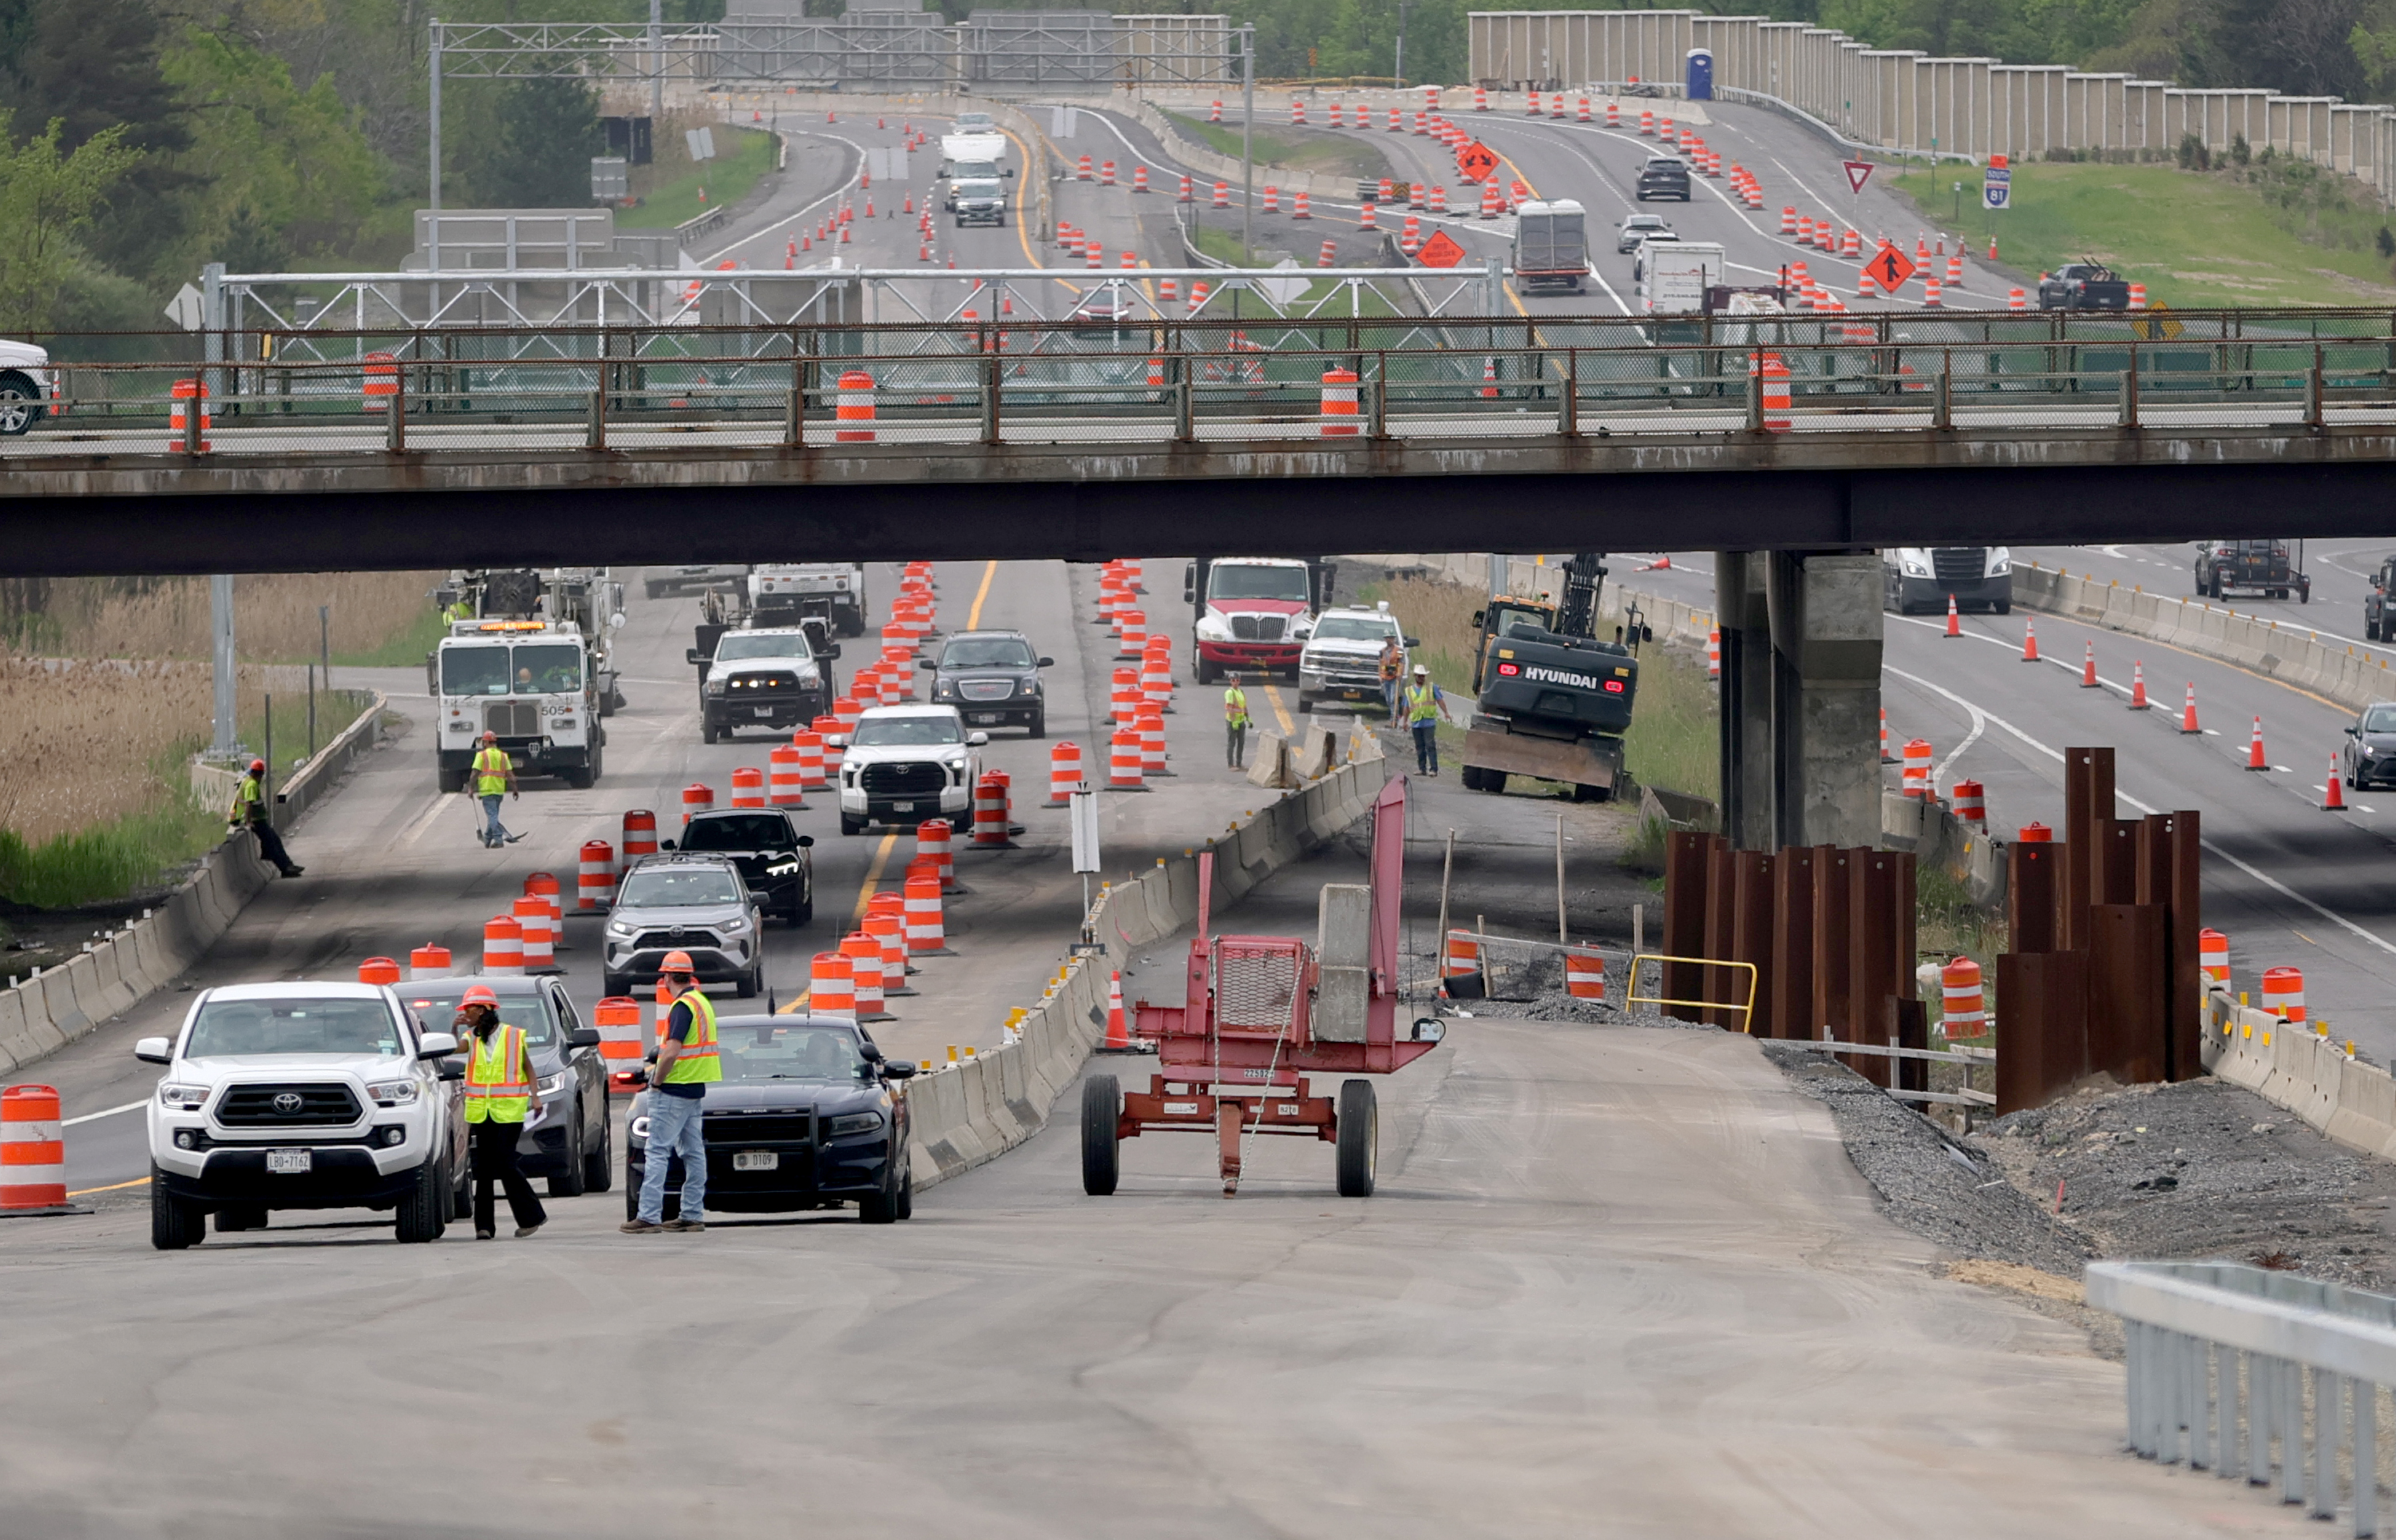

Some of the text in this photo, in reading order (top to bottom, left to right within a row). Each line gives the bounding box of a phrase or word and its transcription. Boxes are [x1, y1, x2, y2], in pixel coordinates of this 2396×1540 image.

[1990, 190, 2003, 201] 81
[1525, 667, 1597, 690] HYUNDAI
[541, 706, 564, 716] 505
[753, 1154, 771, 1166] D109
